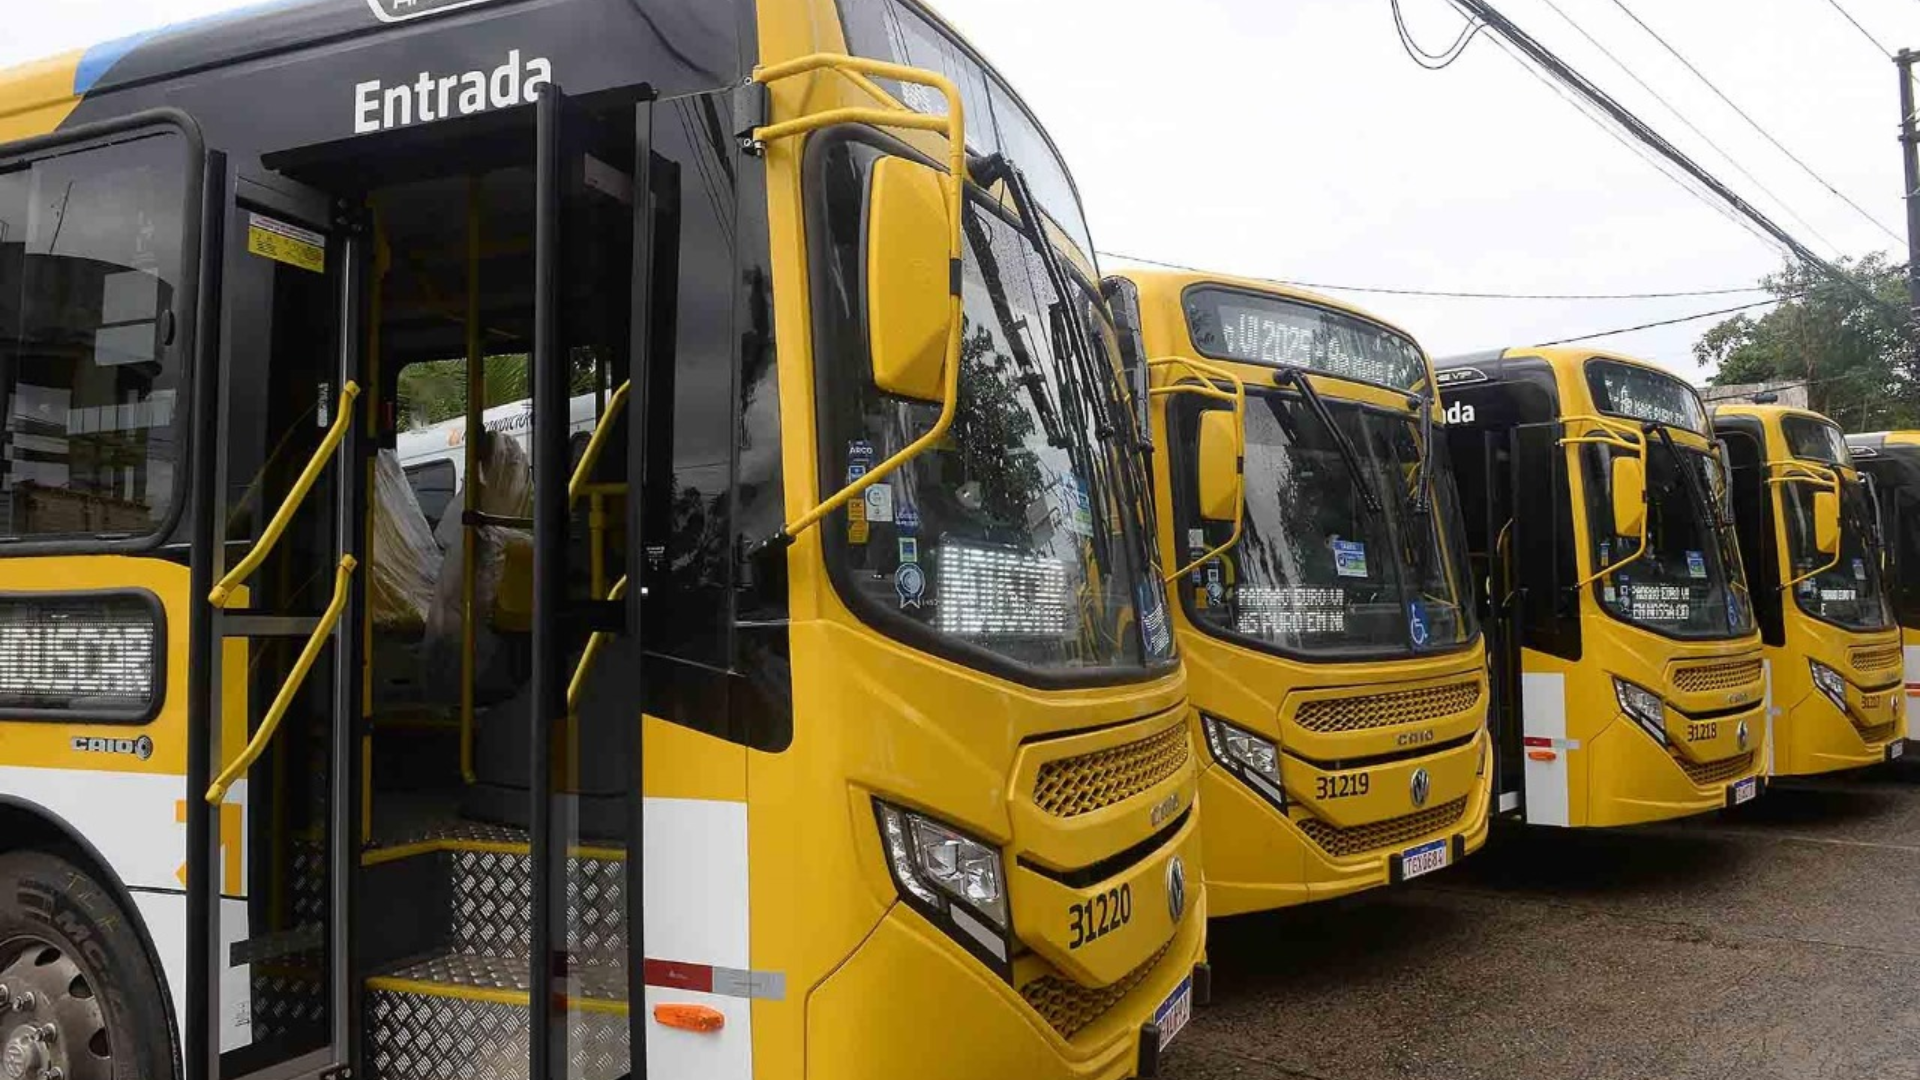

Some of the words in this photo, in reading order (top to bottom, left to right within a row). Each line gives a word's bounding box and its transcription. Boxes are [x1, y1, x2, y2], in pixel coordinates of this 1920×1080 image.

[355, 49, 551, 134] Entrada
[1294, 587, 1326, 606] EURO
[1263, 611, 1302, 633] PURO
[1307, 611, 1326, 632] EM
[1398, 729, 1435, 745] CAIO
[1687, 721, 1717, 742] 31218
[71, 736, 134, 755] CAIO
[1315, 772, 1370, 800] 31219
[1068, 882, 1132, 950] 31220
